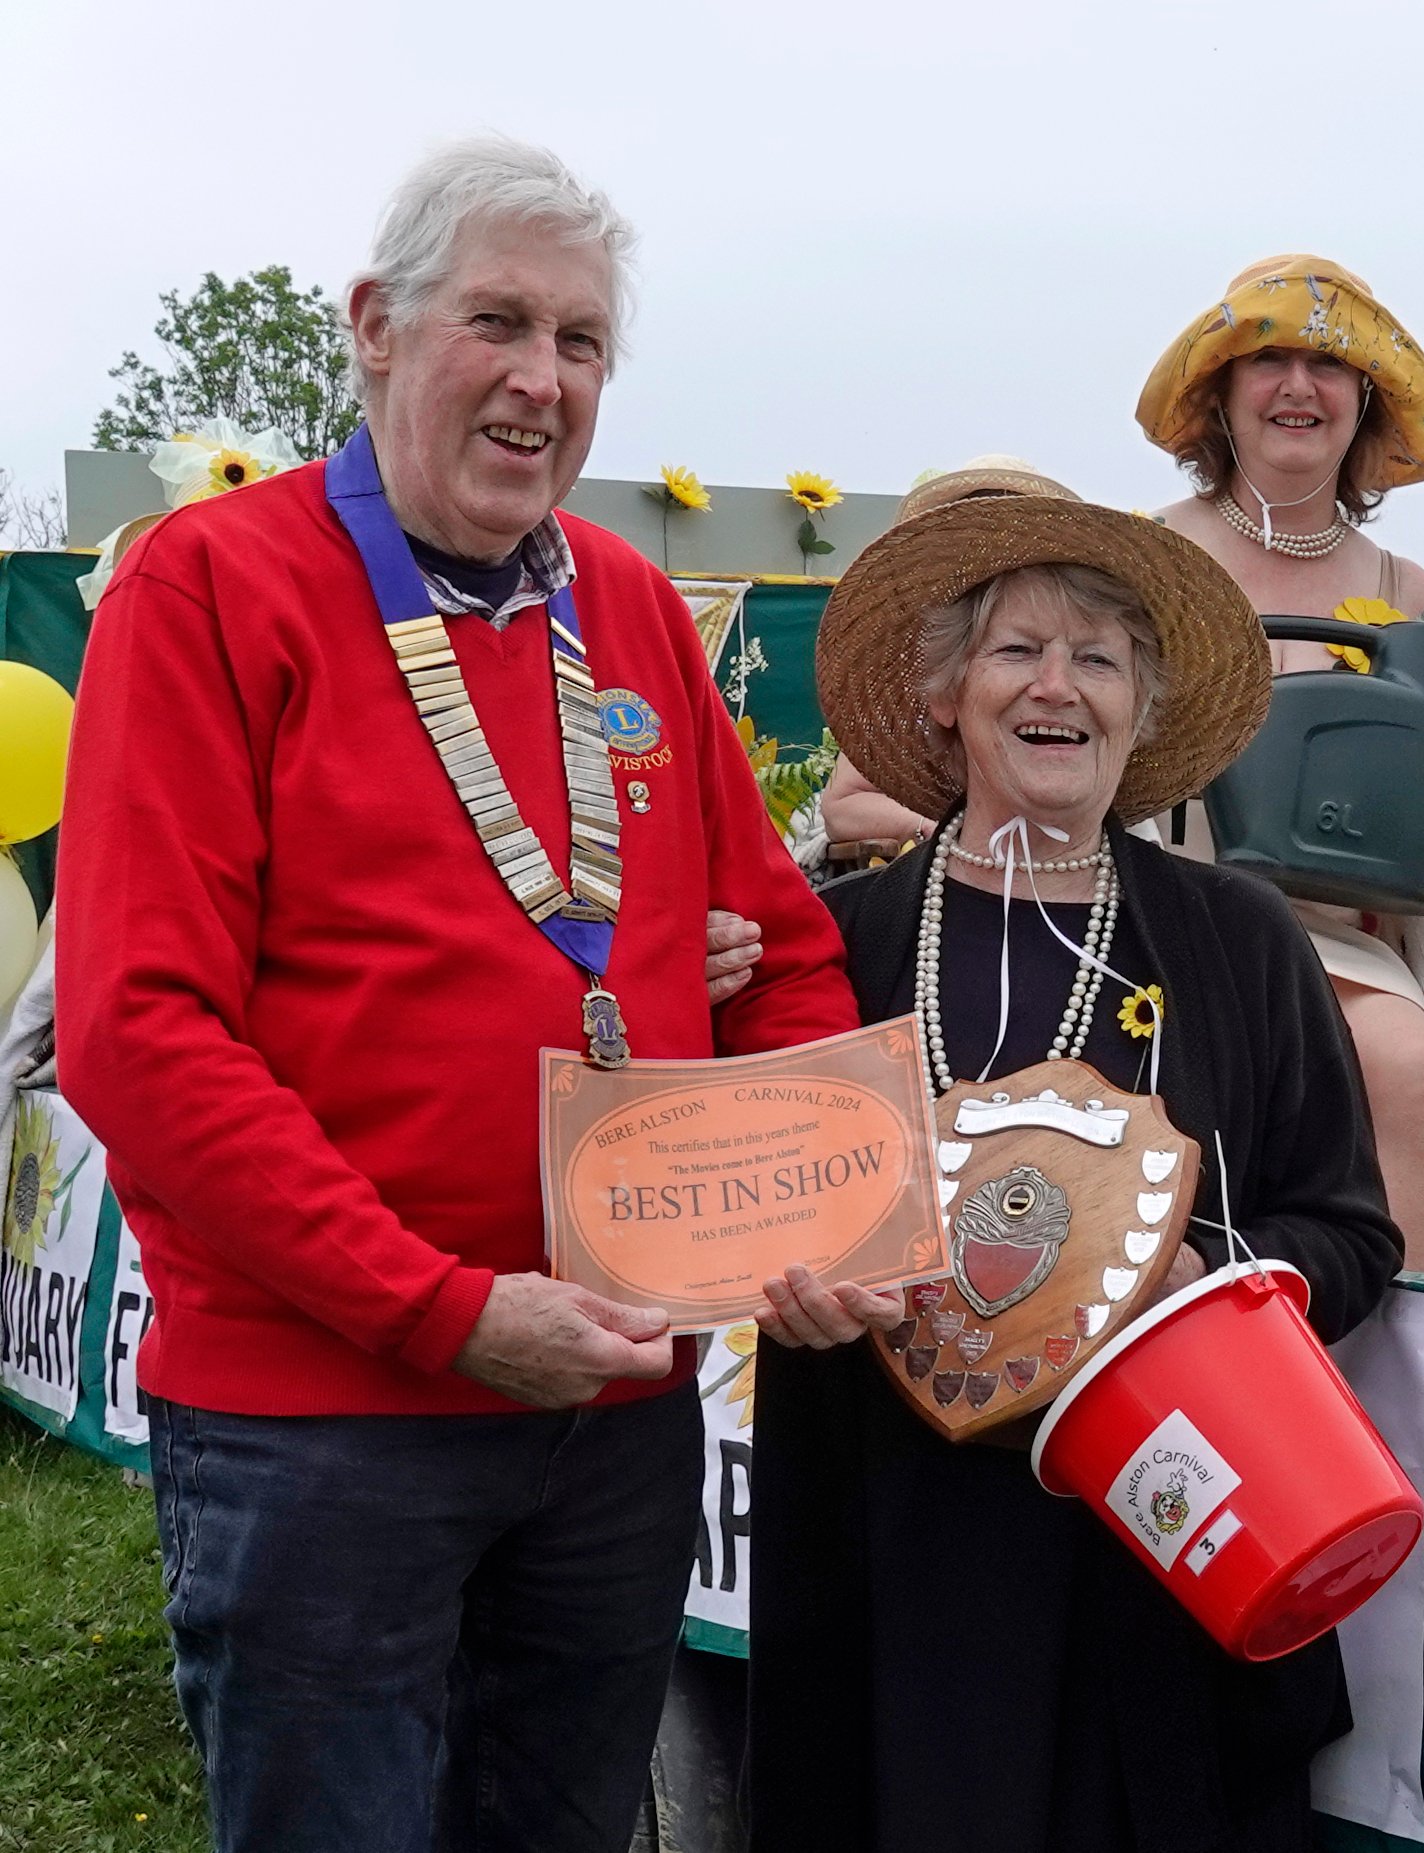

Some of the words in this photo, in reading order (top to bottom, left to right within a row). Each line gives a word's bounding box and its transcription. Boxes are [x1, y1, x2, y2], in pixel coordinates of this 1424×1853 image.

[608, 744, 673, 771] VISTOC
[594, 1122, 637, 1149] BERE
[640, 1099, 707, 1133] ALSTON
[734, 1087, 825, 1106] CARNIVAL
[827, 1094, 862, 1112] 2024
[648, 1141, 670, 1154] This
[671, 1139, 711, 1154] certifies
[713, 1136, 732, 1149] that
[734, 1135, 744, 1148] in
[745, 1131, 763, 1145] this
[765, 1126, 790, 1144] years
[792, 1119, 821, 1135] theme
[607, 1184, 707, 1221] BEST
[718, 1174, 761, 1214] IN
[773, 1140, 886, 1202] SHOW
[690, 1162, 720, 1175] Movies
[722, 1160, 743, 1171] come
[744, 1157, 754, 1166] to
[754, 1153, 774, 1165] Bere
[691, 1228, 718, 1243] HAS
[719, 1222, 753, 1239] BEEN
[754, 1208, 818, 1231] AWARDED
[1126, 1460, 1150, 1508] Alston
[1152, 1449, 1215, 1485] Carnival
[1135, 1512, 1162, 1547] Bere
[1199, 1537, 1216, 1556] 3
